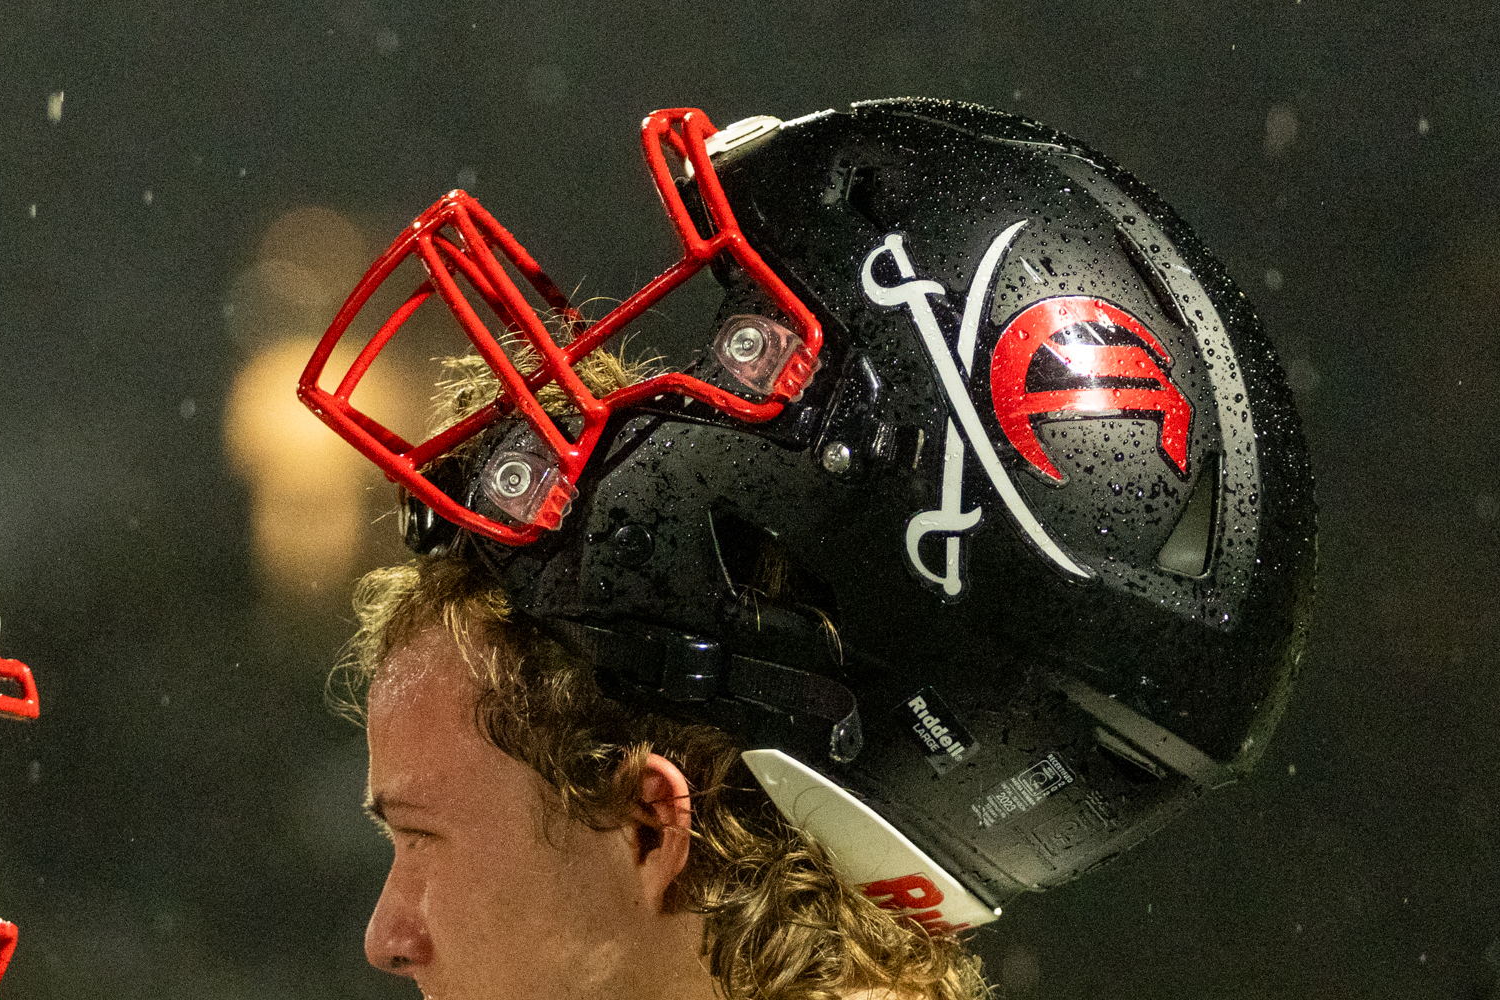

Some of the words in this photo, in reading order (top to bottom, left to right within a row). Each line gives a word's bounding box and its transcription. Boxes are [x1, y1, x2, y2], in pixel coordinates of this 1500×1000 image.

[906, 694, 965, 760] Riddell
[912, 722, 940, 753] LARGE
[1046, 753, 1074, 784] RECERTIFIED
[995, 791, 1017, 813] 2023
